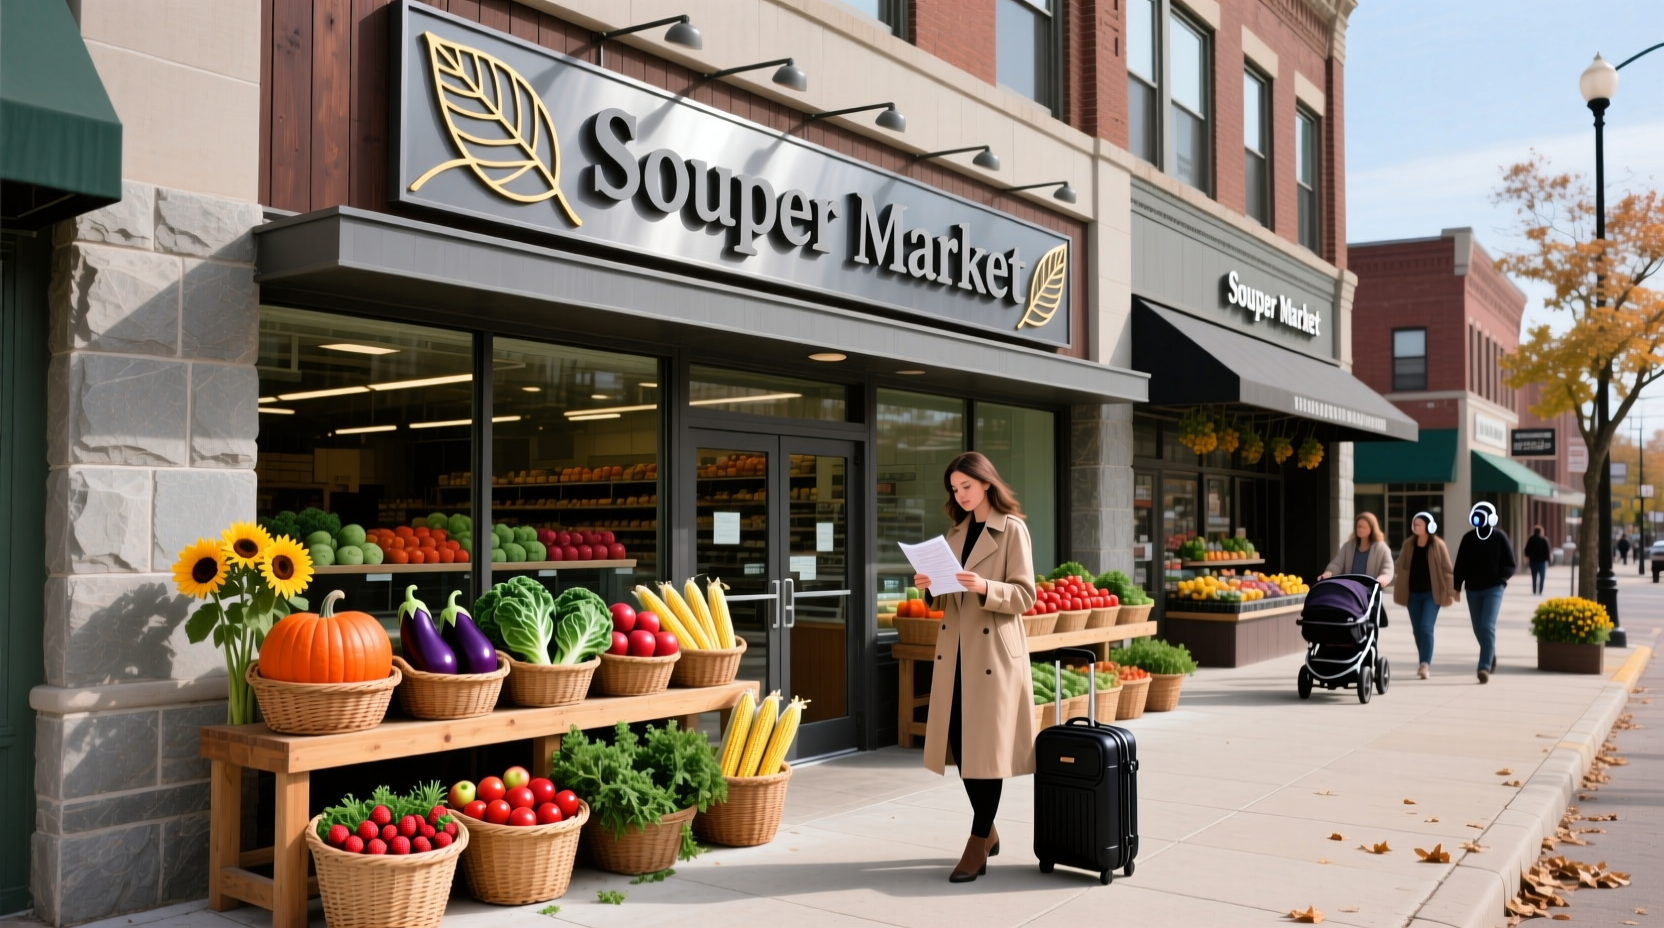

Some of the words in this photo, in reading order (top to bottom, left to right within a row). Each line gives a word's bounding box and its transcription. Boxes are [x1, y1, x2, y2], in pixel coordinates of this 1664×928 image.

[593, 108, 839, 256] Souper
[854, 192, 1026, 304] Market
[1228, 271, 1277, 321] Souper
[1279, 295, 1321, 336] Market
